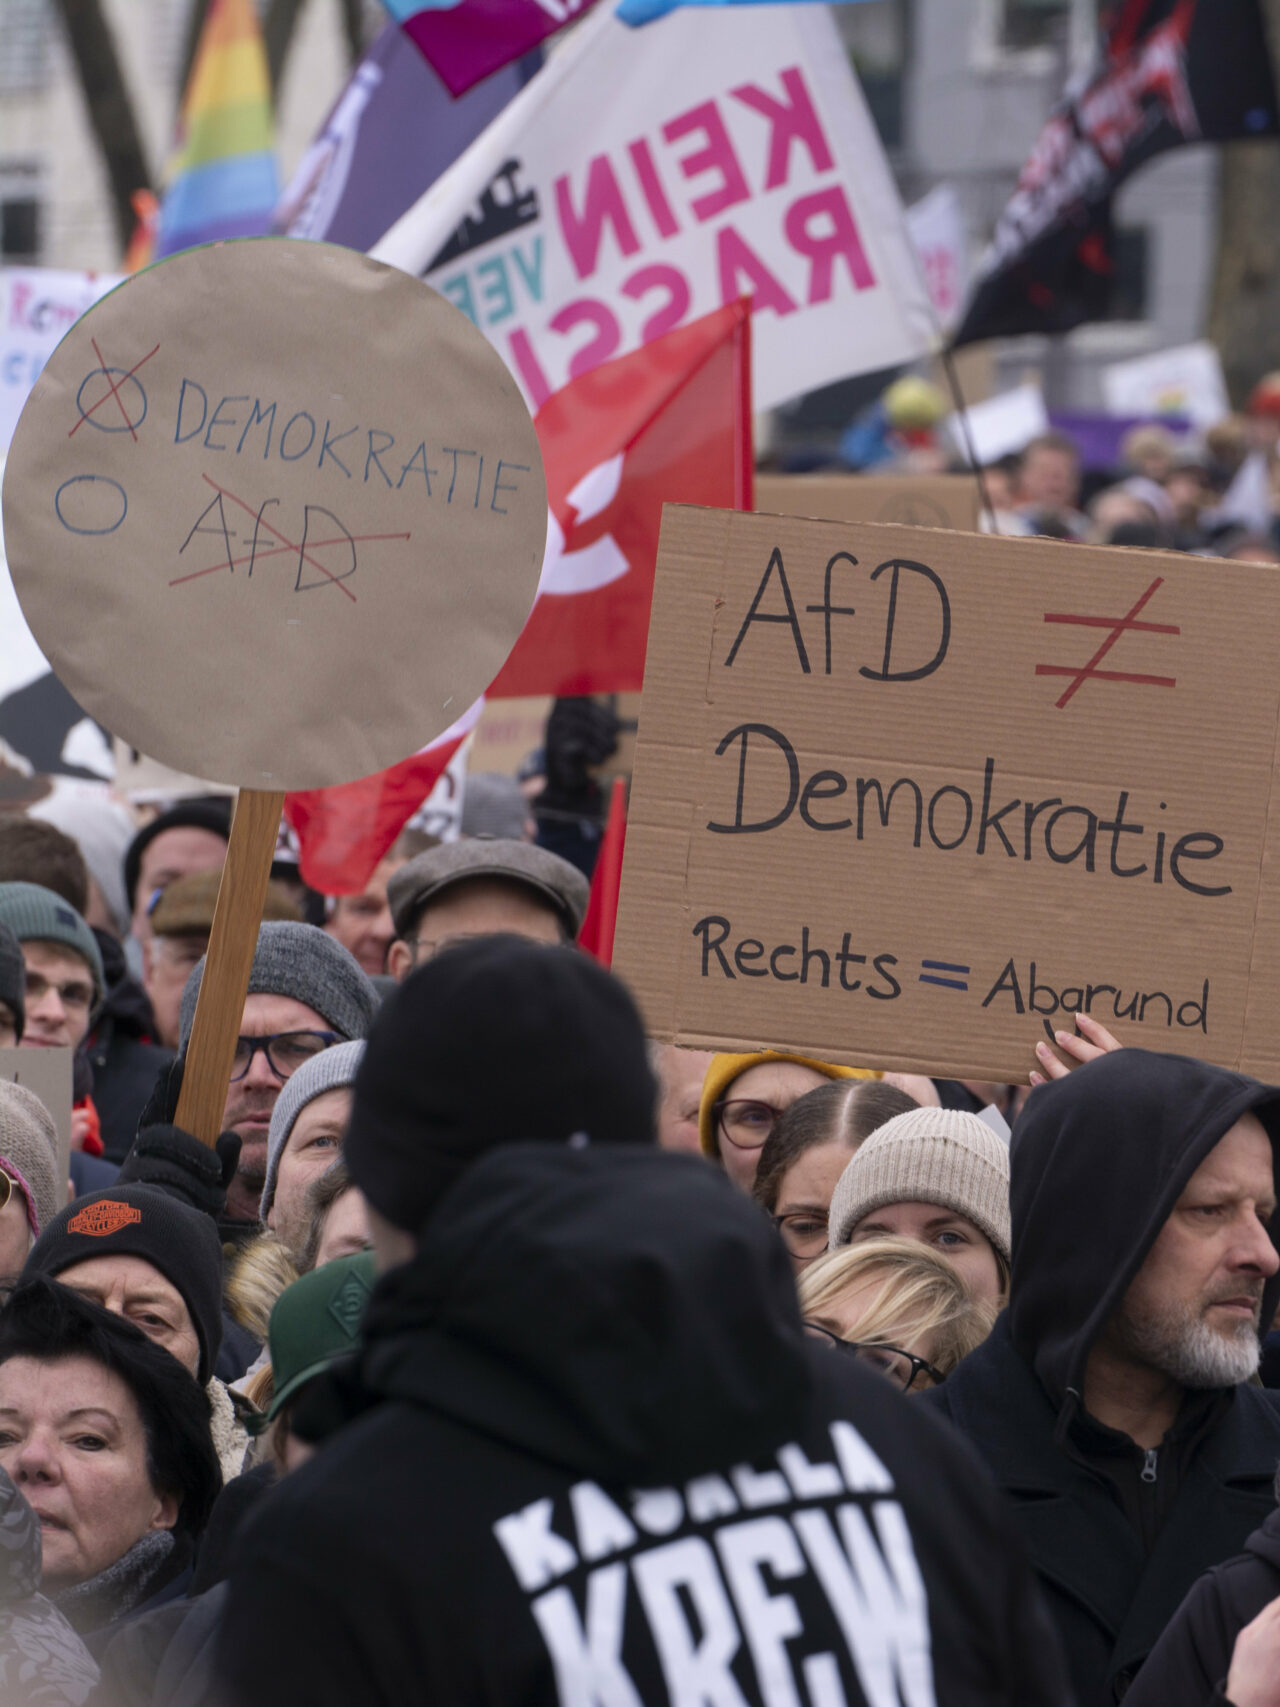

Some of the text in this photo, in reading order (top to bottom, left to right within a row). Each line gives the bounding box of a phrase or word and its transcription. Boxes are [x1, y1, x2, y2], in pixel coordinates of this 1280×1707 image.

[174, 378, 531, 514] DEMOKRATIE
[179, 492, 357, 592] AfD
[725, 547, 951, 682] AfD
[706, 723, 1232, 896] Demokratie
[692, 916, 901, 999] Rechts
[530, 1499, 938, 1707] KREW
